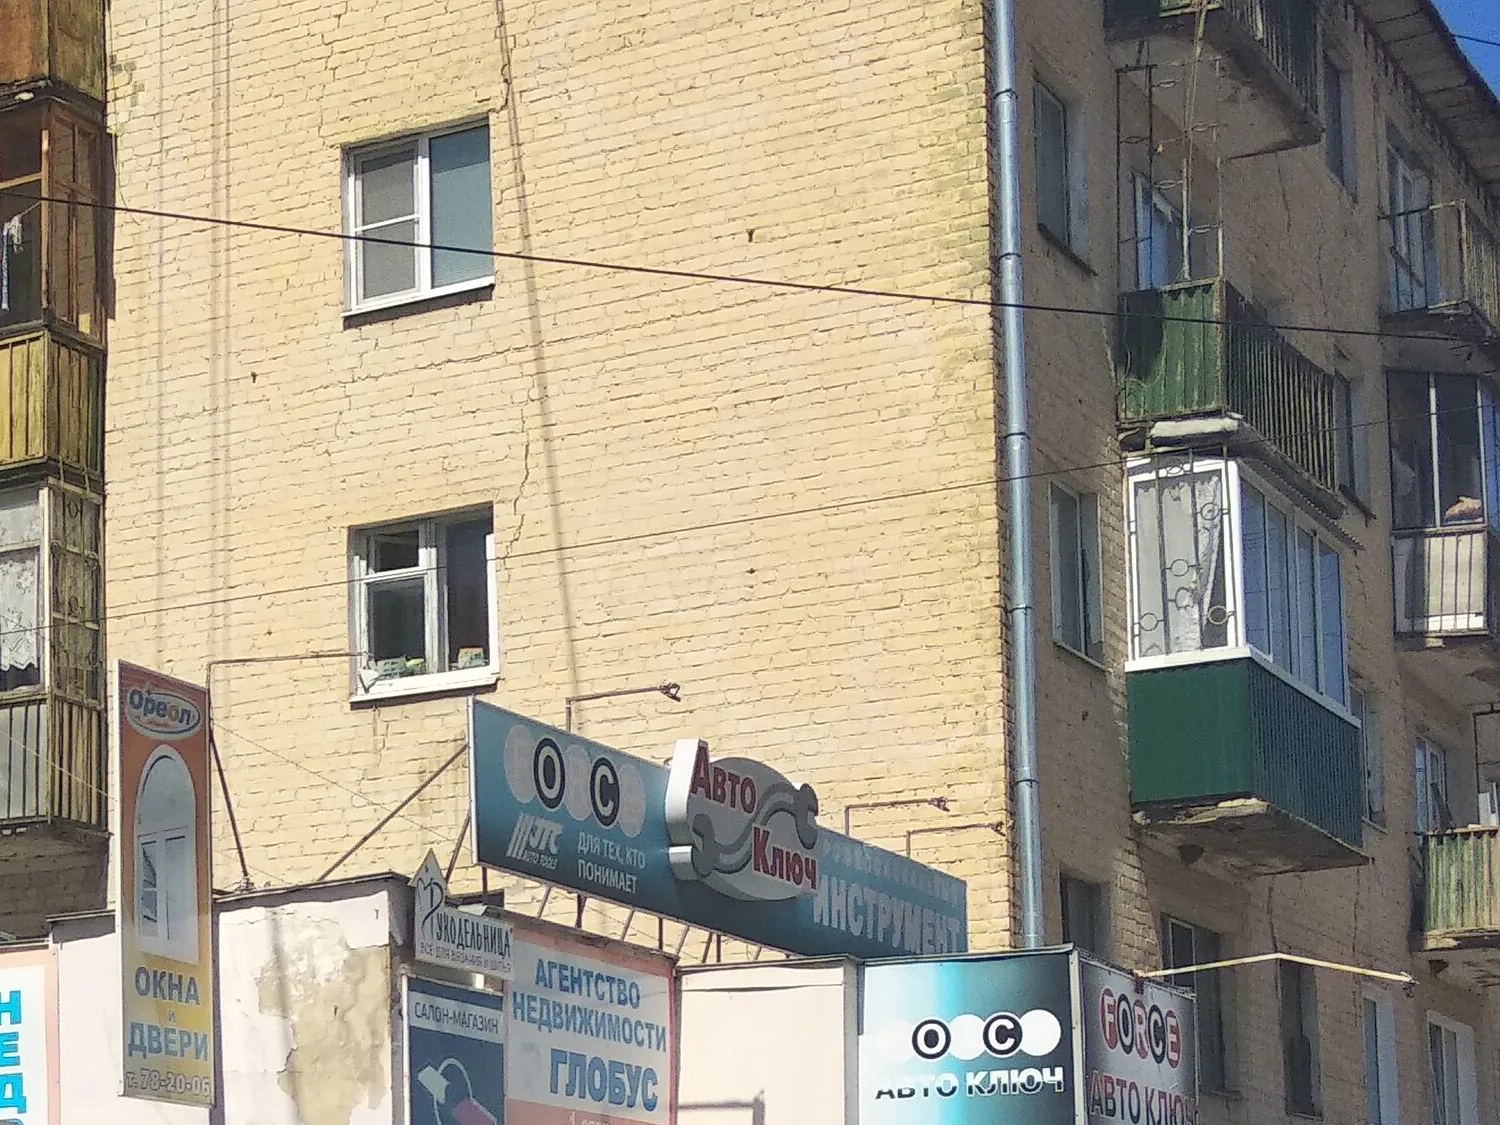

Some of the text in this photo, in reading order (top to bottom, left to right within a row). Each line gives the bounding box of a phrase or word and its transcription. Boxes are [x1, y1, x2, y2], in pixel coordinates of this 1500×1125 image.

[129, 688, 192, 727] Ореол
[578, 831, 601, 854] ДЛЯ
[625, 847, 645, 869] КТО
[578, 859, 637, 894] ПОНИМАЕТ
[813, 875, 960, 952] ИНСТРУМЕНТ
[135, 966, 200, 1005] ОКНА
[535, 958, 640, 1009] АГЕНТСТВО
[414, 1002, 498, 1034] САЛОН-МАГАЗИН
[513, 991, 667, 1052] НЕДВИЖИМОСТИ
[1102, 988, 1181, 1068] FORCE
[128, 1021, 208, 1061] ДВЕРИ
[139, 1067, 210, 1097] 78-20-06
[550, 1047, 658, 1112] ГЛОБУС
[966, 1067, 1064, 1096] КЛЮЧ
[1091, 1072, 1141, 1124] АВТО
